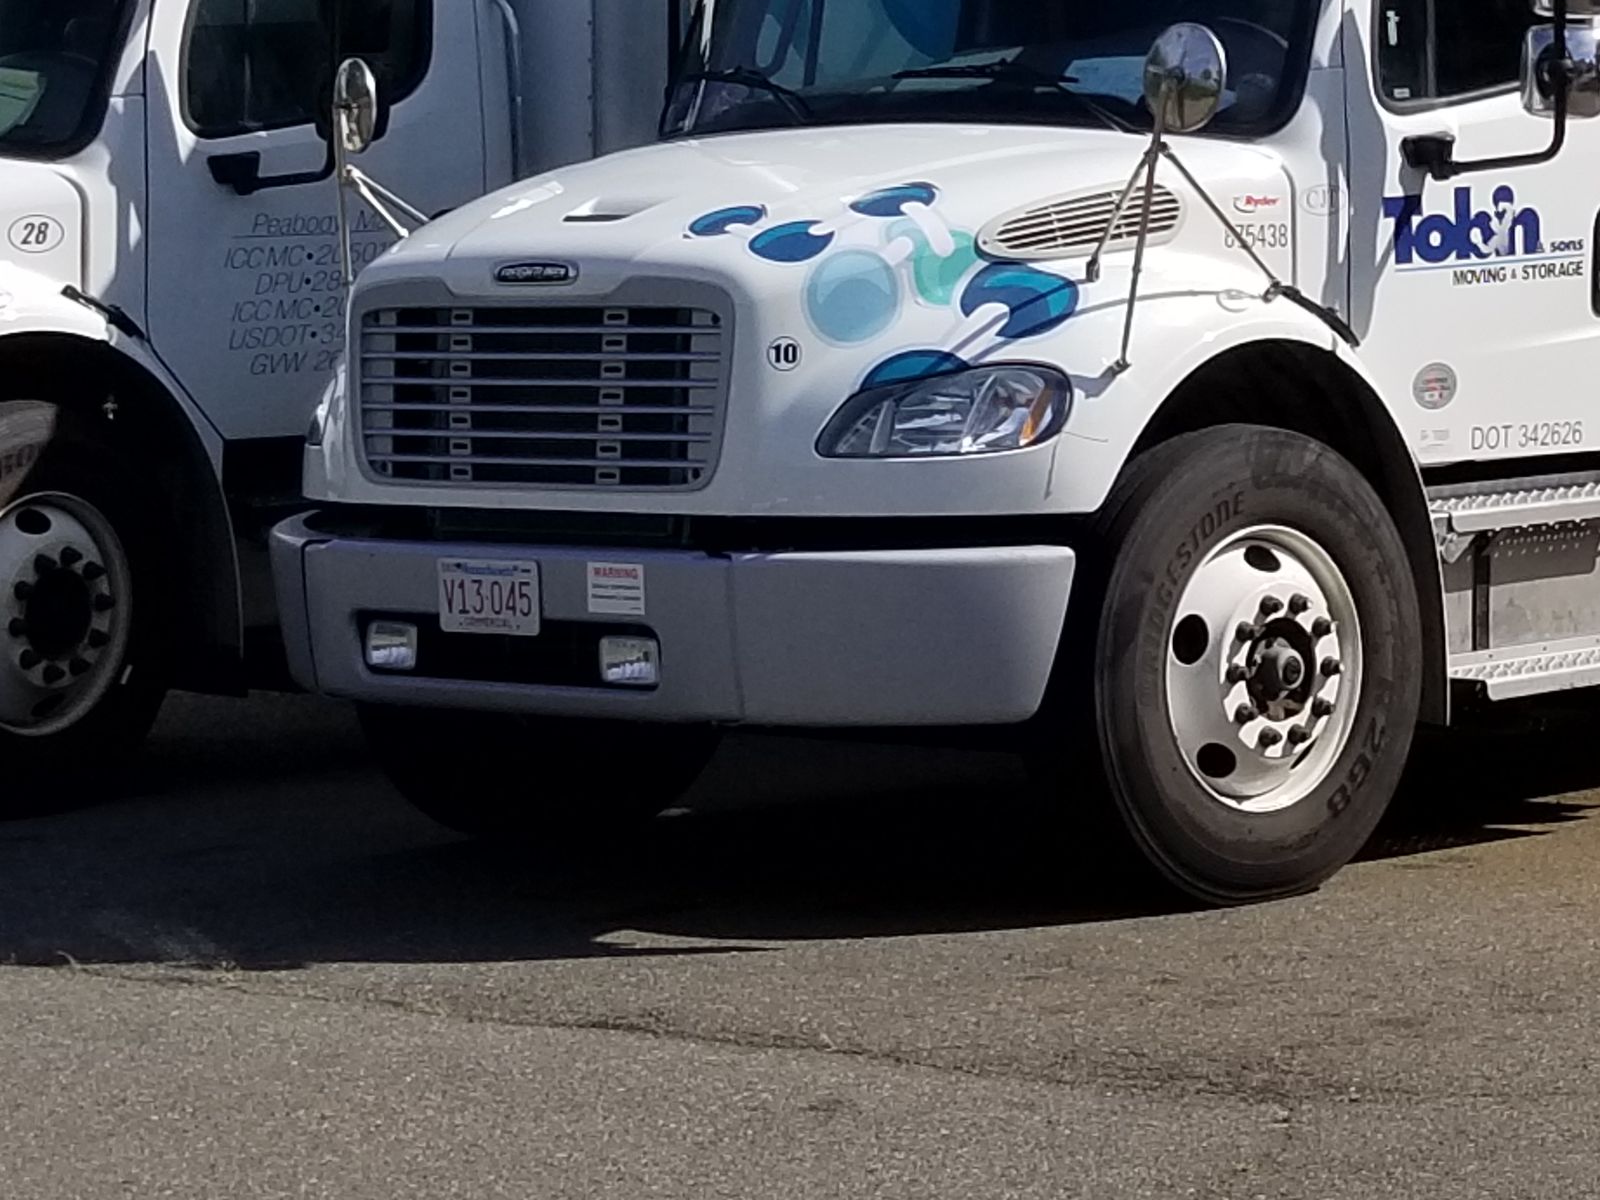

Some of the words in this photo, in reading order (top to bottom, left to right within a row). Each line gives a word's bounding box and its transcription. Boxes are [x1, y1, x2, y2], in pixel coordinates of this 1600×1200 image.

[20, 221, 50, 245] 28
[1550, 238, 1584, 253] sons
[1452, 267, 1507, 286] MOVING
[1521, 260, 1584, 281] STORAGE
[768, 343, 798, 364] 10
[1471, 424, 1513, 450] DOT
[1518, 420, 1583, 448] 342626
